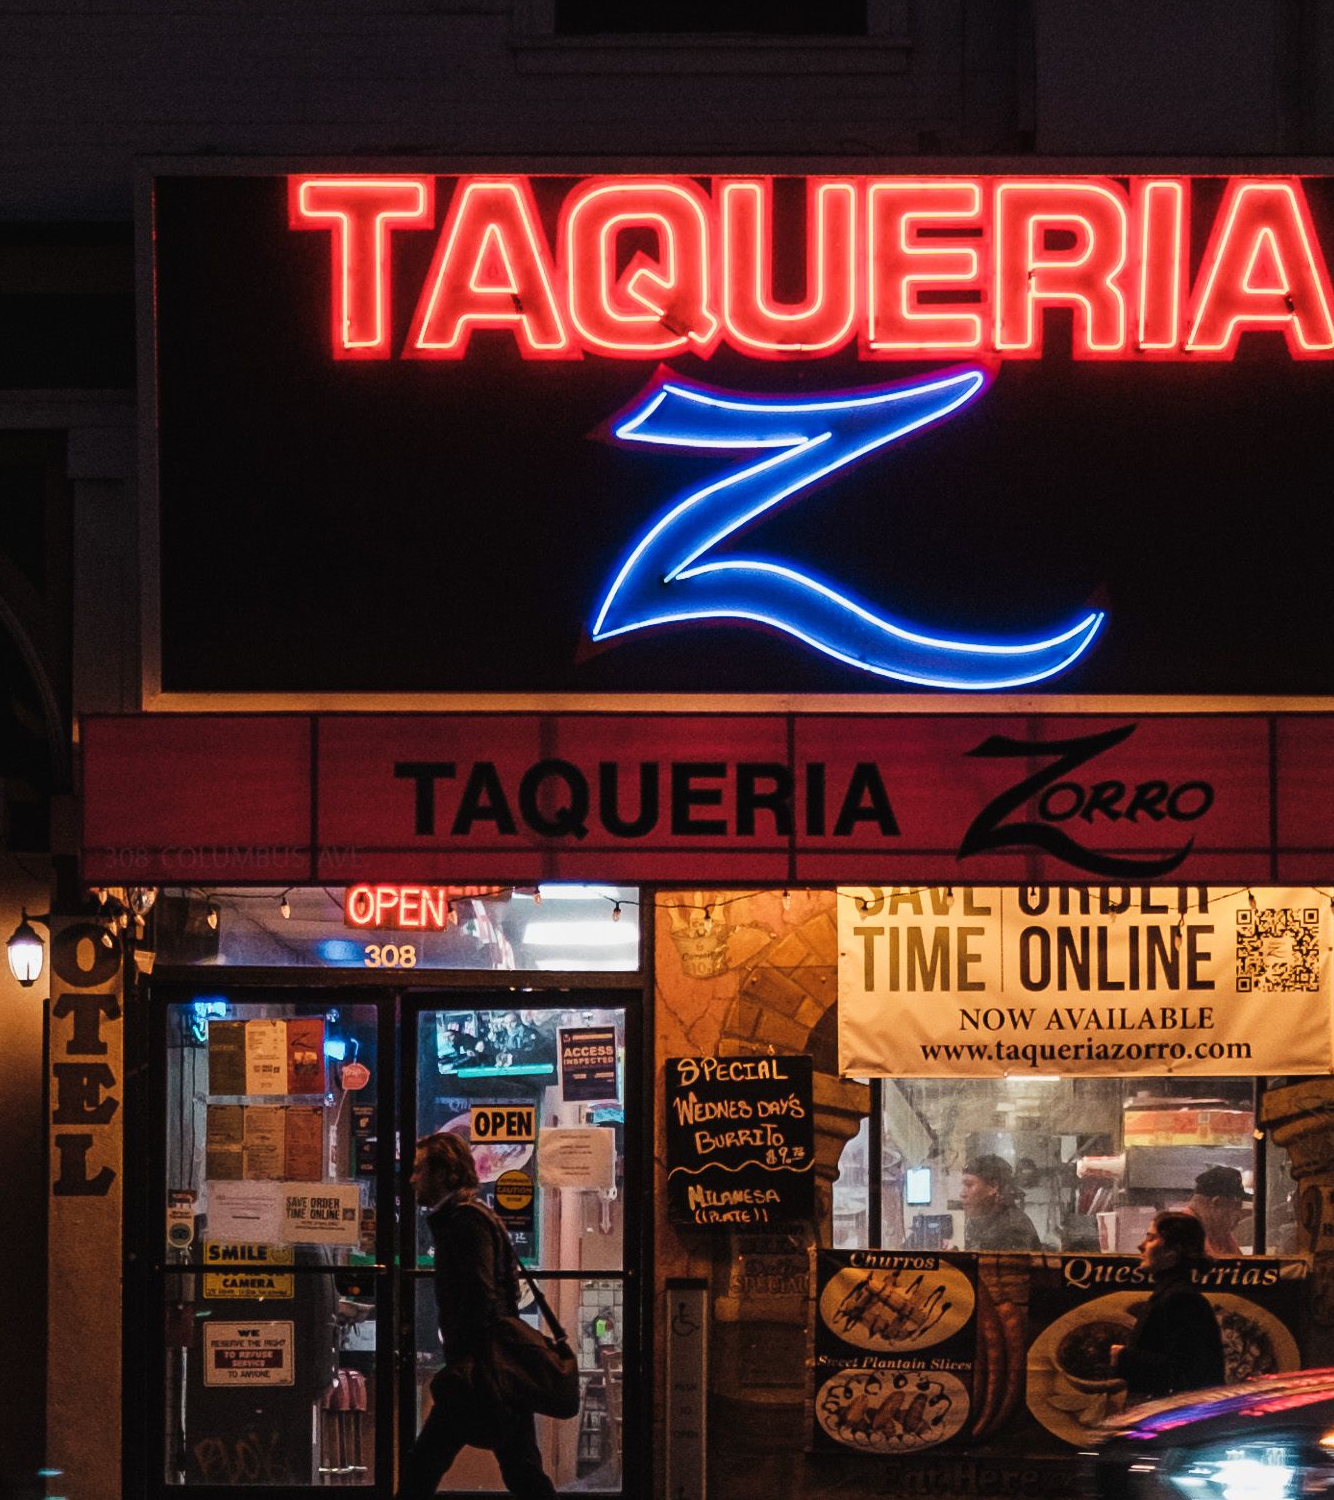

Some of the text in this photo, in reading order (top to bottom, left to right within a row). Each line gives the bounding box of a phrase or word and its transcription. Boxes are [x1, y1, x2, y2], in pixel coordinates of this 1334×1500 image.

[582, 366, 1107, 690] Z
[395, 723, 1213, 877] TAQUERIA ZORRO
[105, 848, 149, 869] 308
[161, 847, 309, 869] COLUMBUS
[347, 884, 447, 927] OPEN
[364, 944, 417, 969] 308
[853, 925, 1215, 992] TIME ONLINE
[959, 1007, 1215, 1031] NOW AVAILABLE
[564, 1046, 614, 1057] ACCESS
[564, 1056, 614, 1066] INSPECTED
[921, 1038, 1252, 1068] www.taqueriazorro.com
[676, 1057, 789, 1088] SPECIAL
[475, 1111, 532, 1137] OPEN
[694, 1123, 784, 1155] BURRITO
[687, 1184, 781, 1210] MILANESA
[208, 1245, 268, 1260] SMILE
[849, 1252, 936, 1269] Churros
[222, 1278, 275, 1288] CAMERA
[817, 1354, 973, 1371] Sweet Plantain Slices
